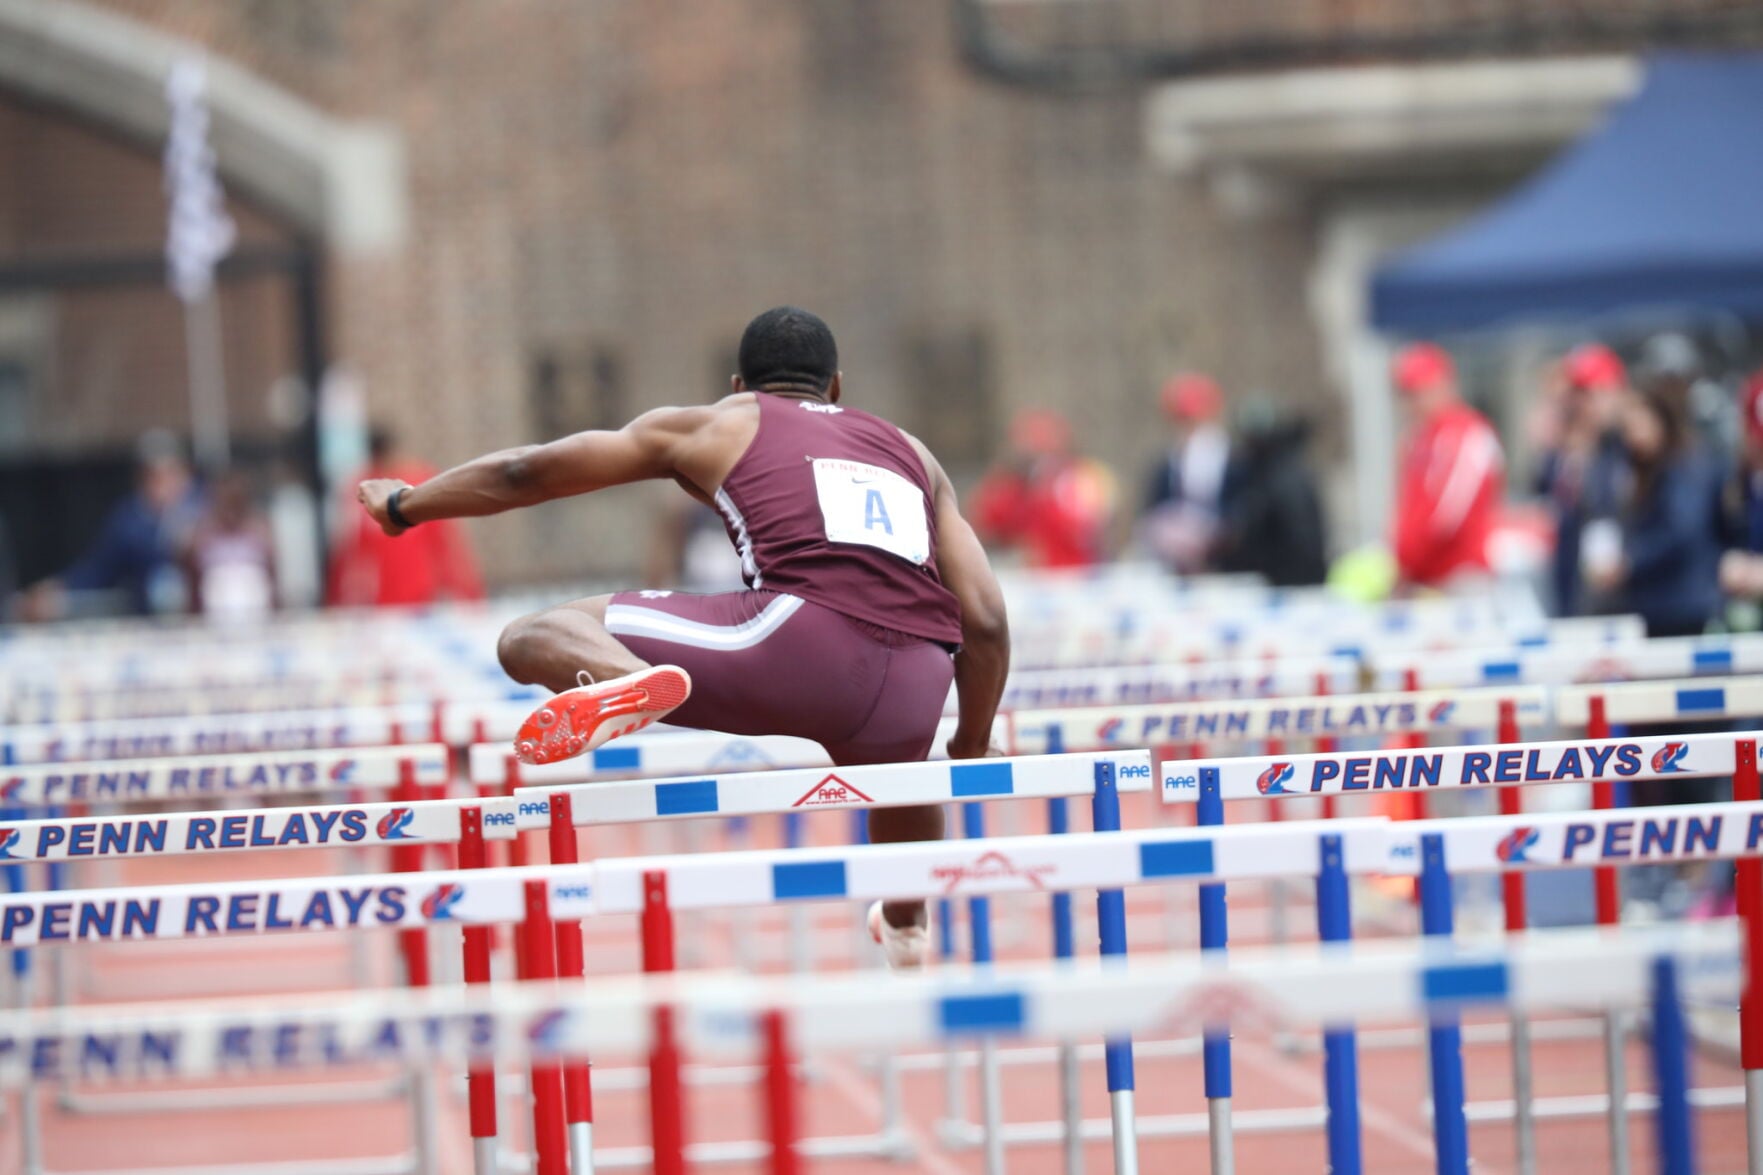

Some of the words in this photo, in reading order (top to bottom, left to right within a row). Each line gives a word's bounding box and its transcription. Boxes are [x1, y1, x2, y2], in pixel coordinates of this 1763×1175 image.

[865, 489, 894, 536] A
[1142, 711, 1249, 738] PENN
[1268, 703, 1417, 731] RELAYS
[43, 770, 151, 798] PENN
[169, 758, 317, 788] RELAYS
[1310, 754, 1443, 792] PENN
[1460, 744, 1643, 784] RELAYS
[36, 820, 168, 857] PENN
[185, 810, 368, 850] RELAYS
[1563, 815, 1723, 860] PENN
[1, 898, 161, 942] PENN
[184, 887, 407, 932] RELAYS
